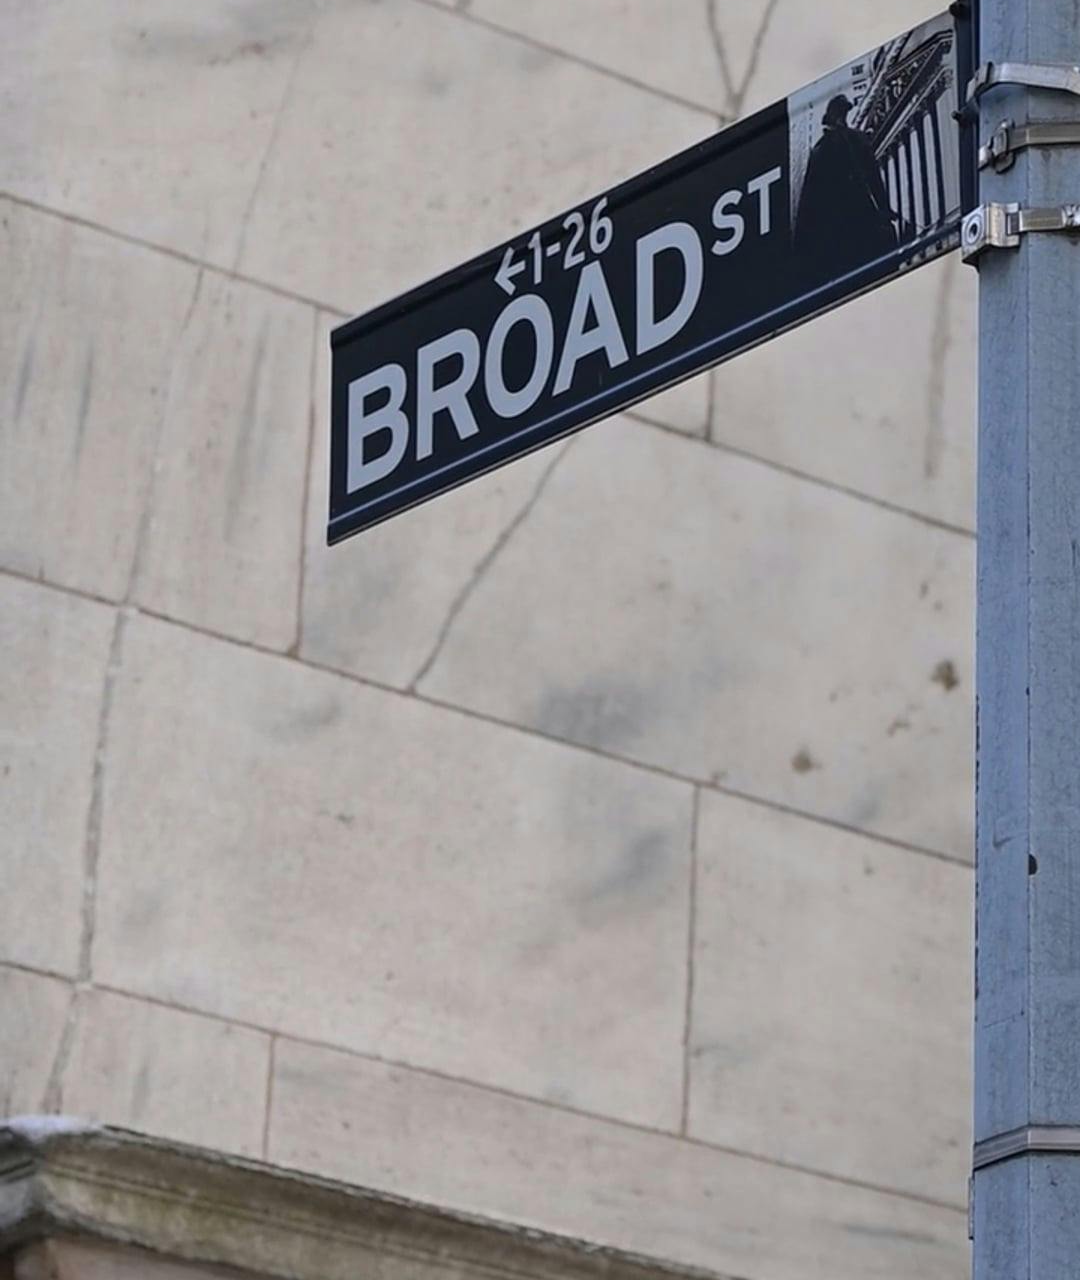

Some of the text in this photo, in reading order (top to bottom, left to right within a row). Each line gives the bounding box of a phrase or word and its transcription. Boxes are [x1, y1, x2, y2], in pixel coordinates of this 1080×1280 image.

[346, 165, 782, 495] BROAD ST
[527, 197, 614, 285] 1-26
